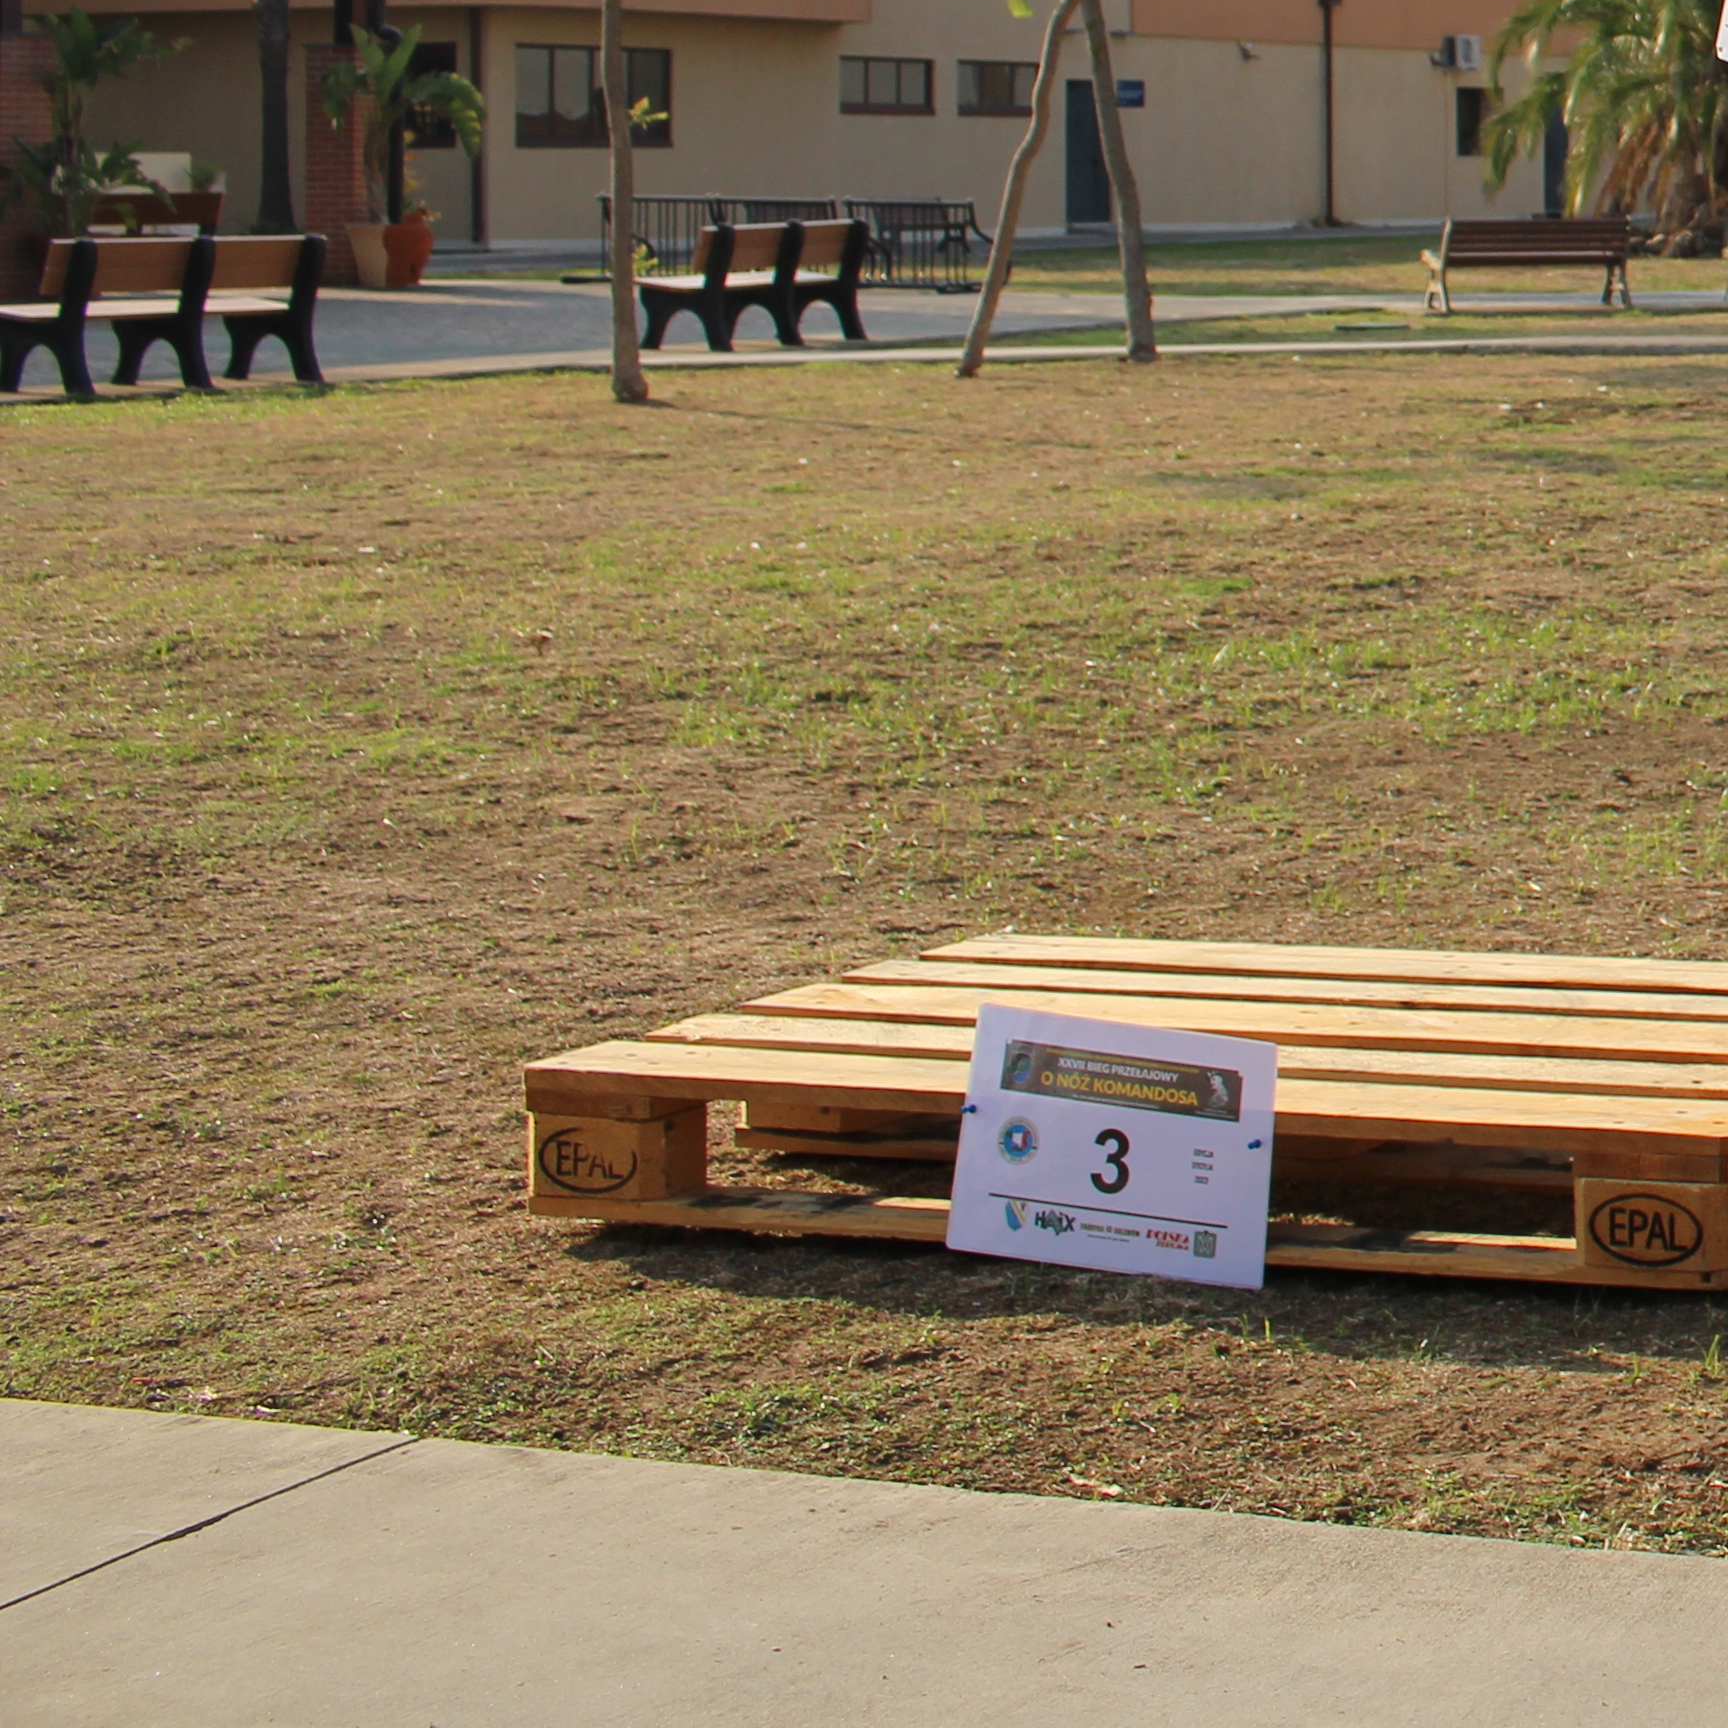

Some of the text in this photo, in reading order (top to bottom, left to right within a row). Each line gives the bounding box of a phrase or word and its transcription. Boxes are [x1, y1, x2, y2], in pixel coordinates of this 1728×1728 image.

[1040, 1071, 1053, 1086] O
[1056, 1071, 1090, 1091] NÓŻ
[1092, 1077, 1199, 1106] KOMANDOSA
[1057, 1057, 1085, 1071] XXVII
[1087, 1060, 1111, 1074] BIEG
[1111, 1064, 1179, 1083] PRZEŁAJOWY
[555, 1139, 625, 1180] EPAL
[1090, 1127, 1131, 1194] 3
[1609, 1207, 1689, 1253] EPAL
